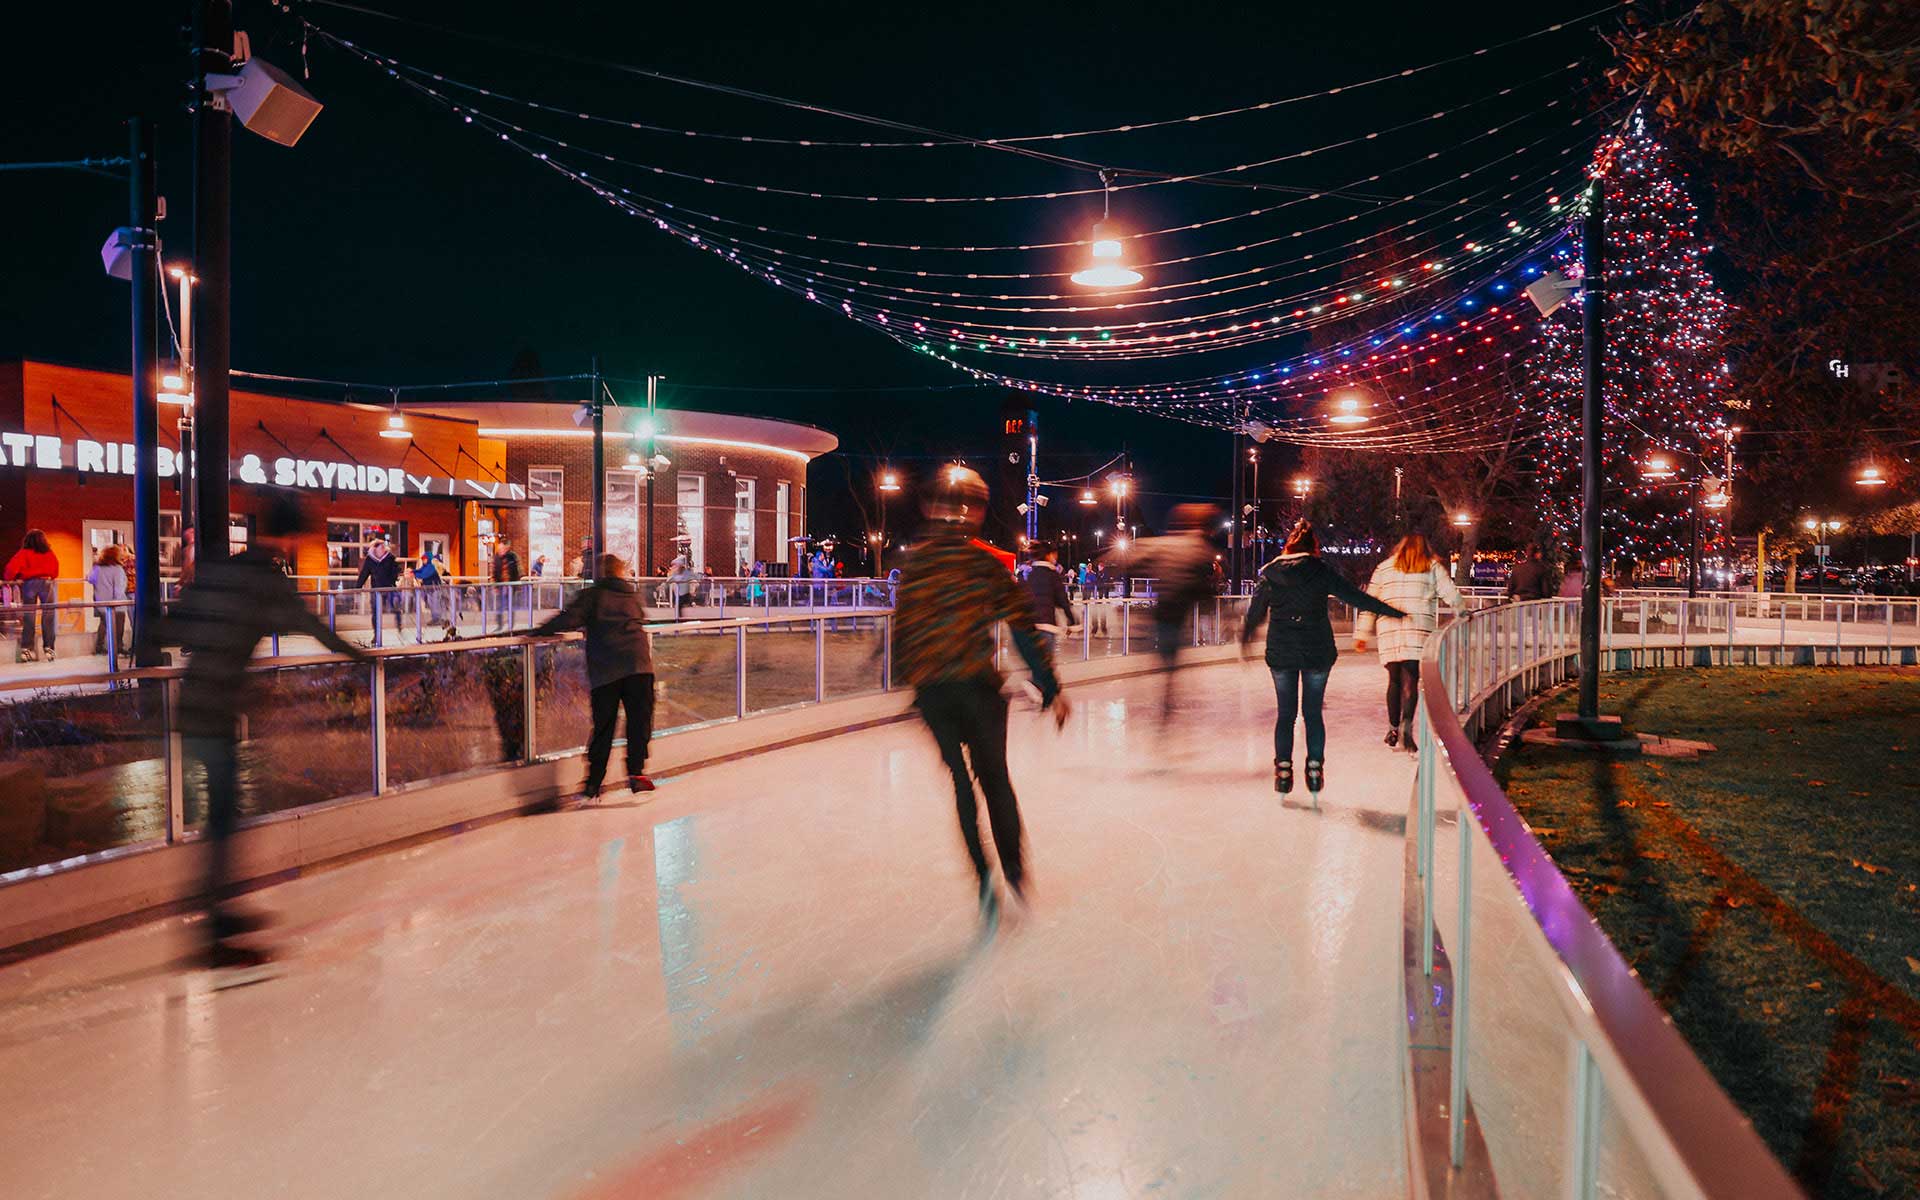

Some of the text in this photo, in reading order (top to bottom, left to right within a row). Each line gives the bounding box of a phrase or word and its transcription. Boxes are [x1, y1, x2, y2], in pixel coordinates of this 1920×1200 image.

[0, 432, 405, 494] TE RIBBO & SKYRIDE
